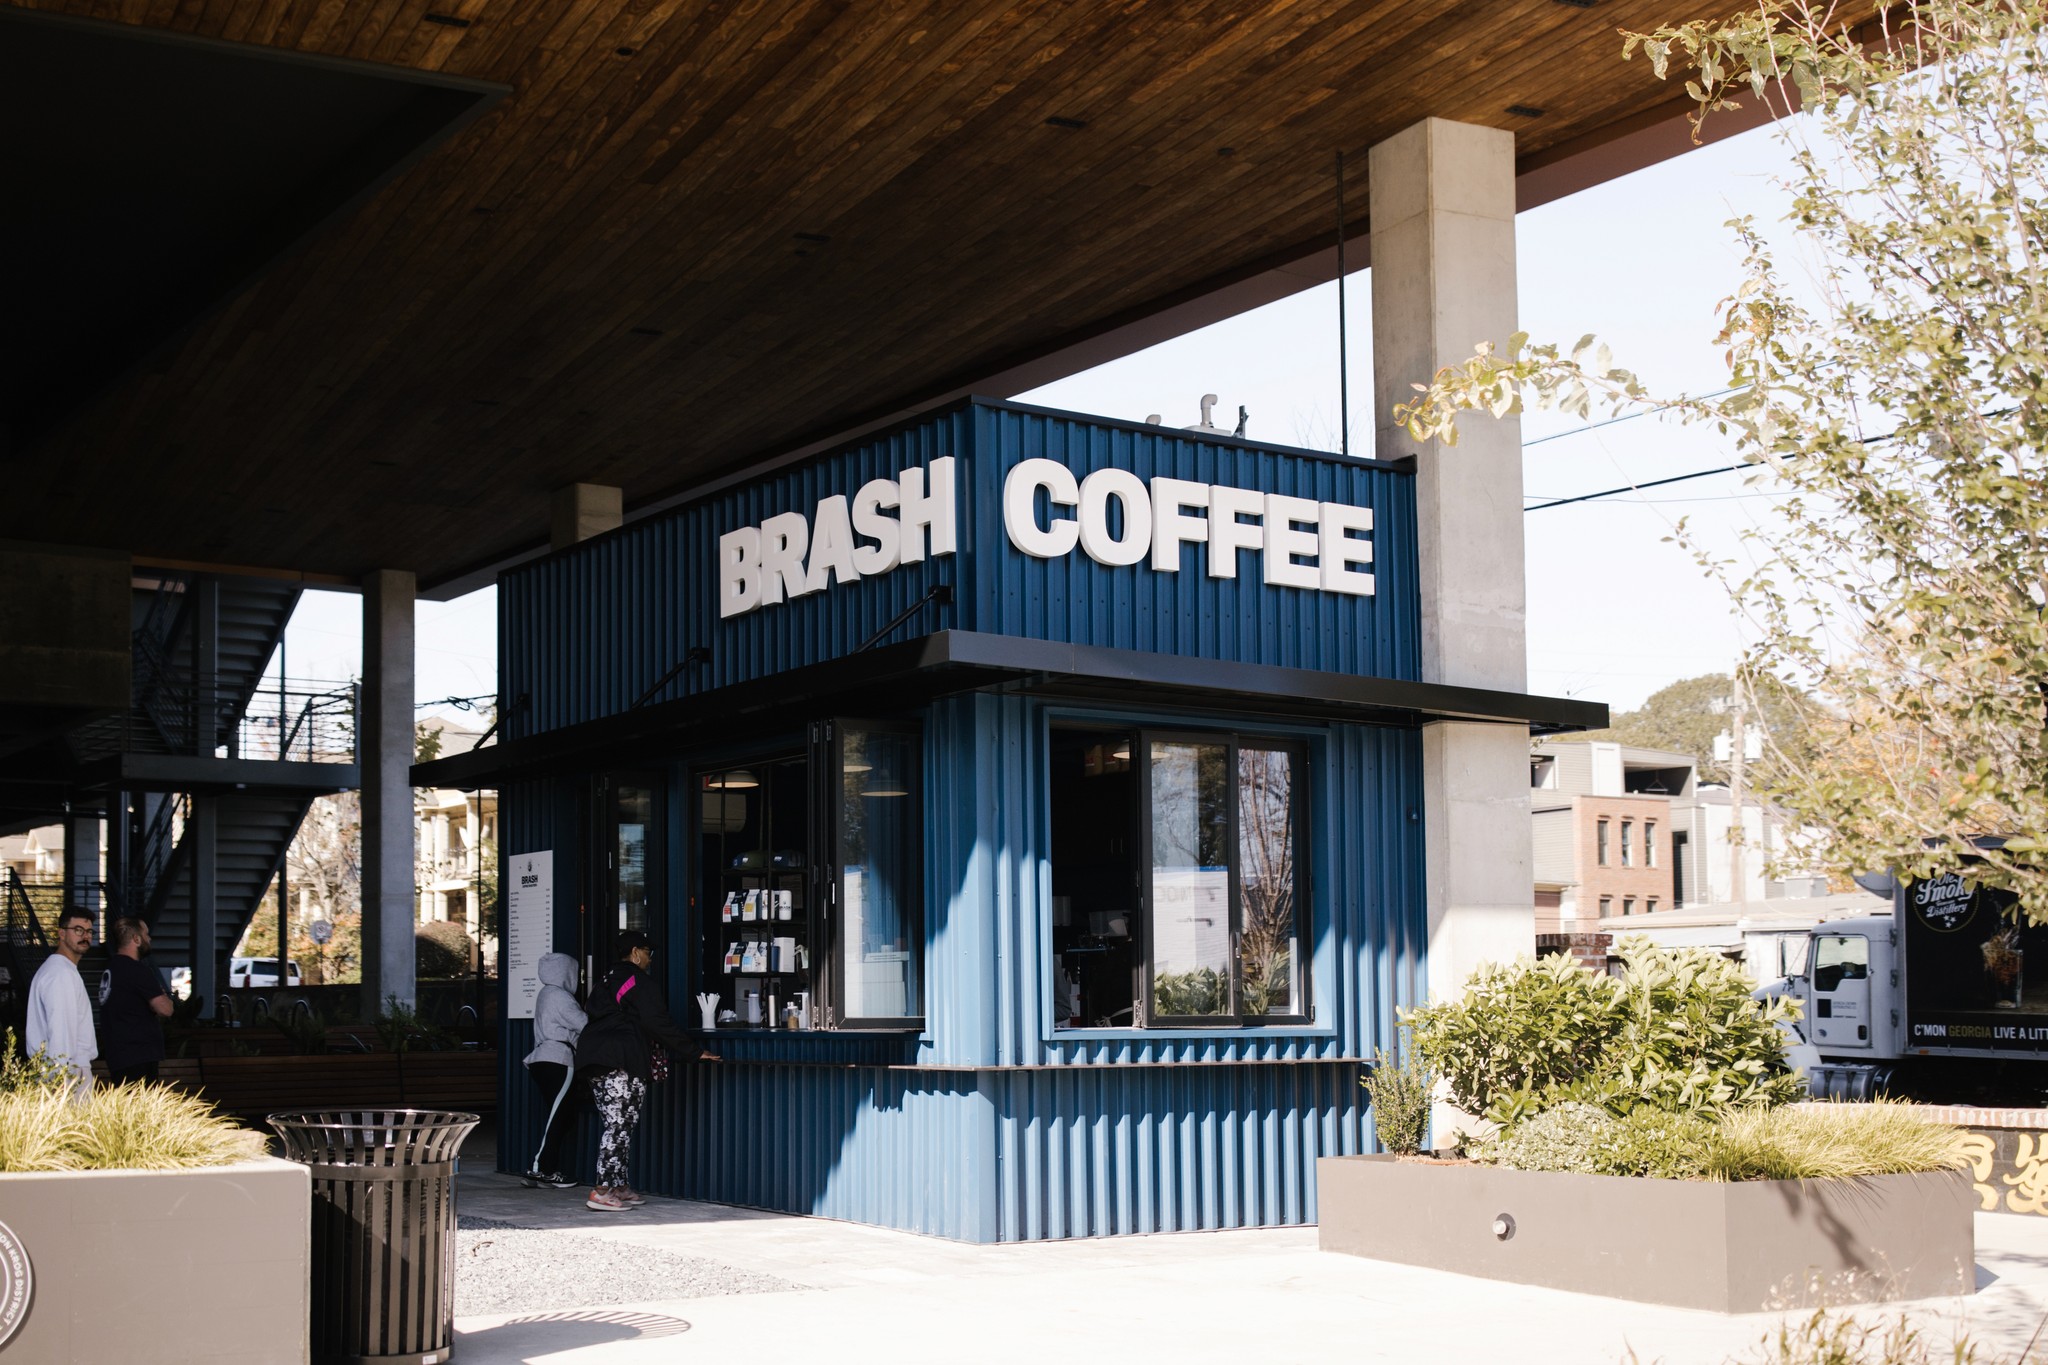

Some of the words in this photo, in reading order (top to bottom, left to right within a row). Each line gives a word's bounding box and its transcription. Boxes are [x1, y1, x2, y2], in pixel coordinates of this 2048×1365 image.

[720, 455, 956, 619] BRASH
[1003, 457, 1375, 597] COFFEE
[521, 874, 538, 885] BRASH
[1926, 902, 1968, 918] Distillery
[1914, 1024, 1946, 1036] C'MON
[1948, 1025, 1992, 1038] GEORGIA
[1994, 1026, 2017, 1039] LIVE
[2019, 1027, 2027, 1039] A
[3, 1278, 24, 1326] DISTRICT
